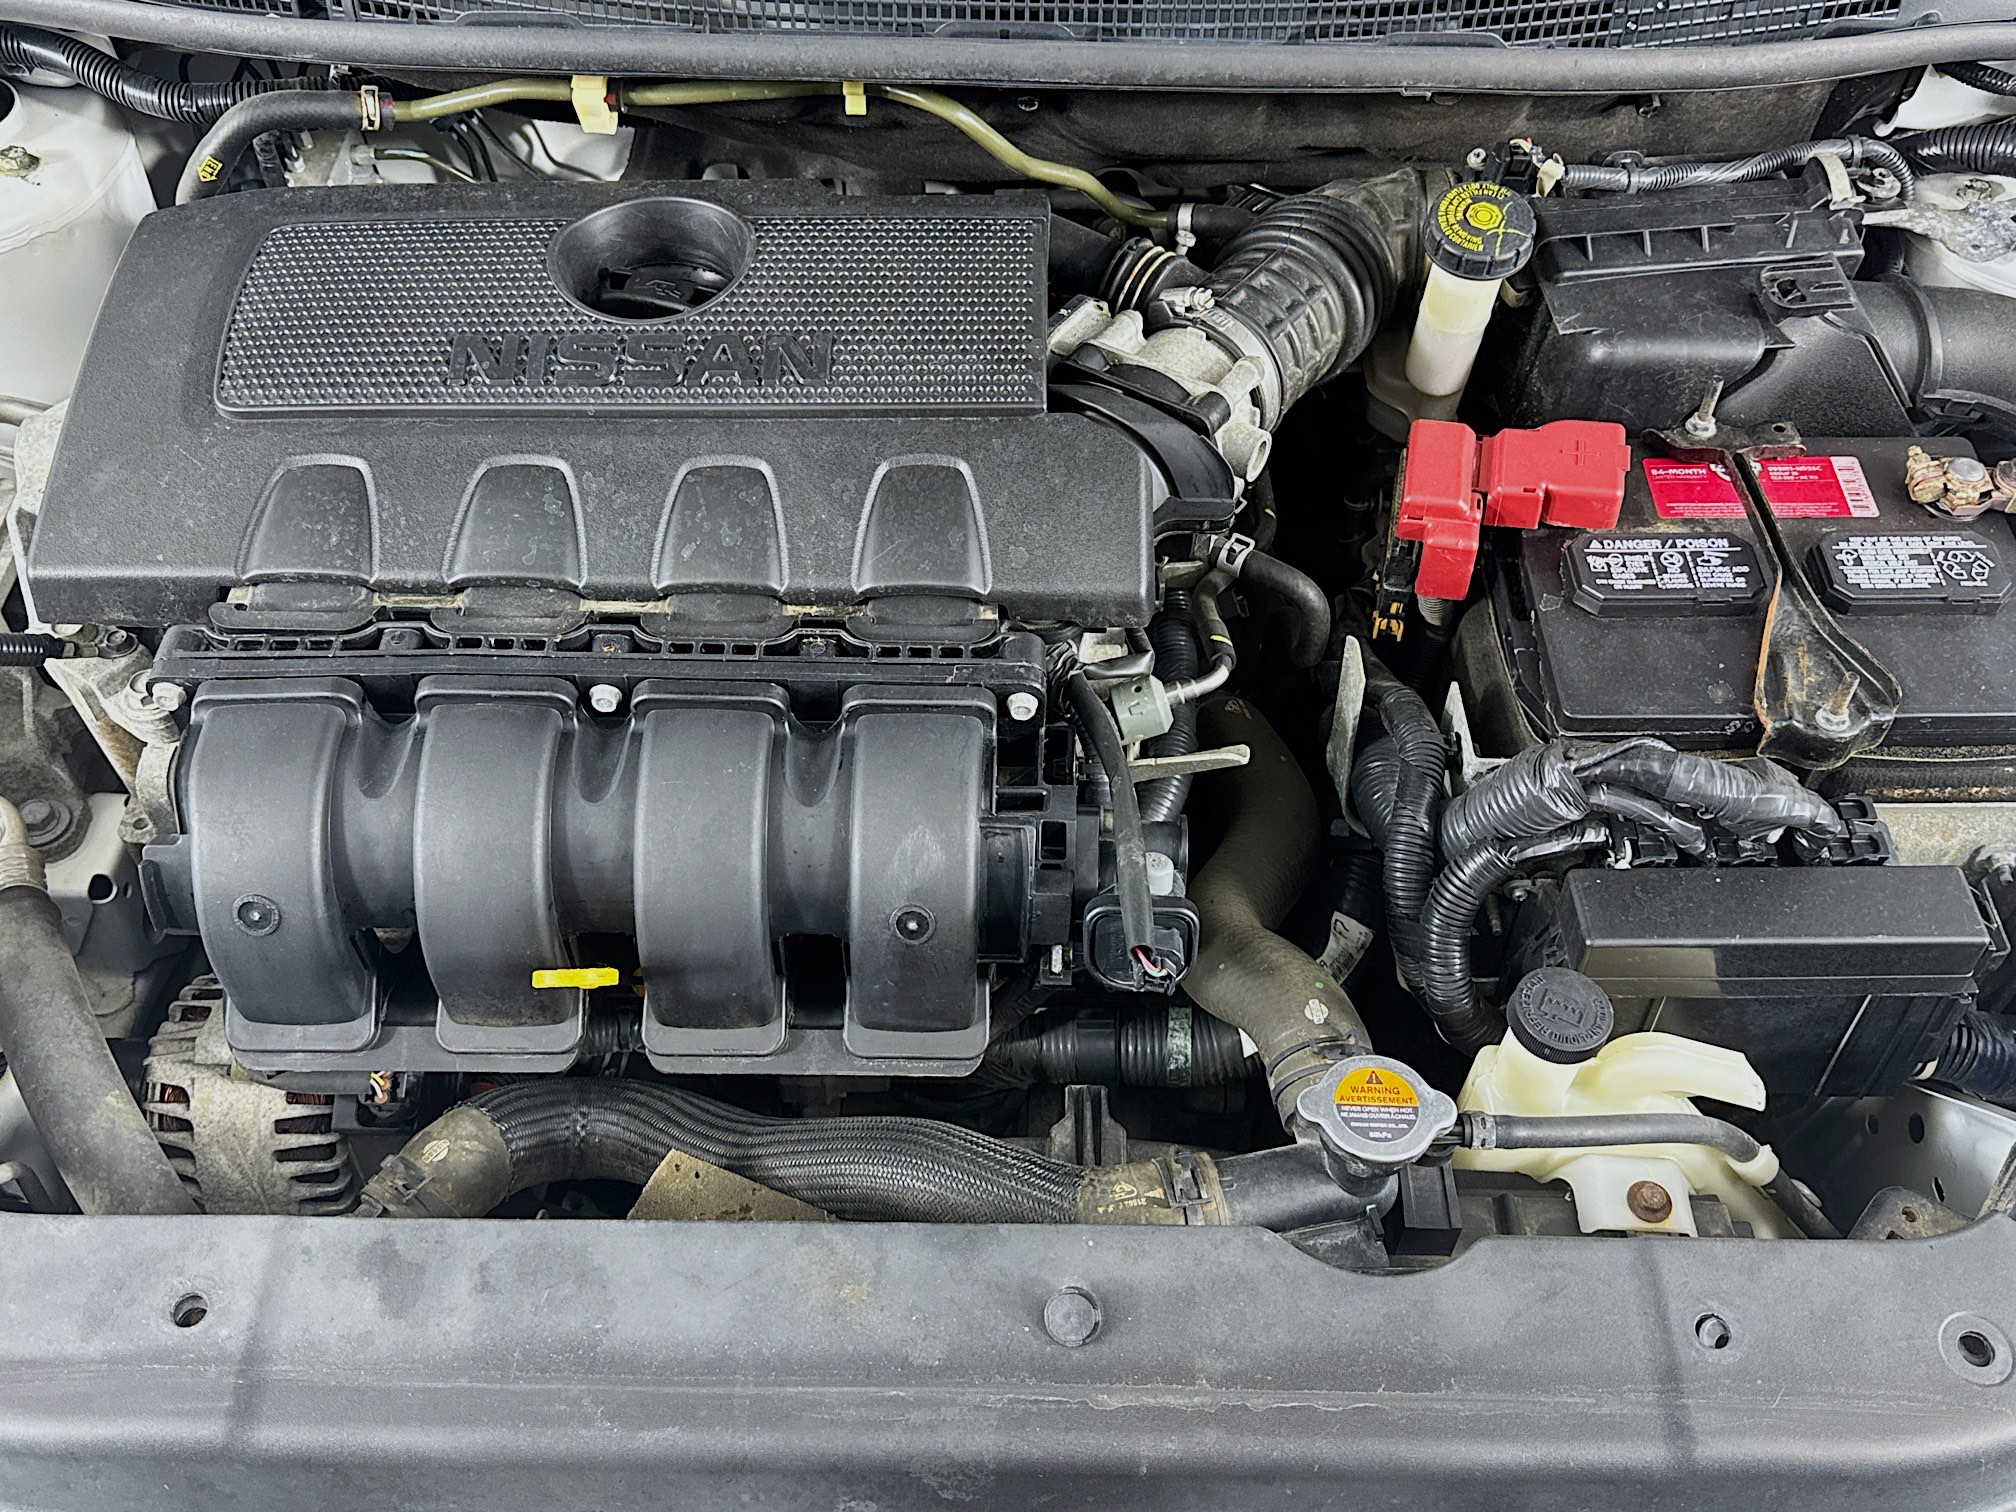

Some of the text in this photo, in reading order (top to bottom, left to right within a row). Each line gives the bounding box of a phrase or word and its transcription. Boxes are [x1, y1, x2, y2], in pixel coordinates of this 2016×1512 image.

[447, 333, 834, 387] NISSAN
[1604, 540, 1662, 550] DANGER
[1676, 538, 1729, 548] POISON
[1350, 1086, 1400, 1095] WARNING
[1340, 1096, 1413, 1104] AVERTISSEMENT
